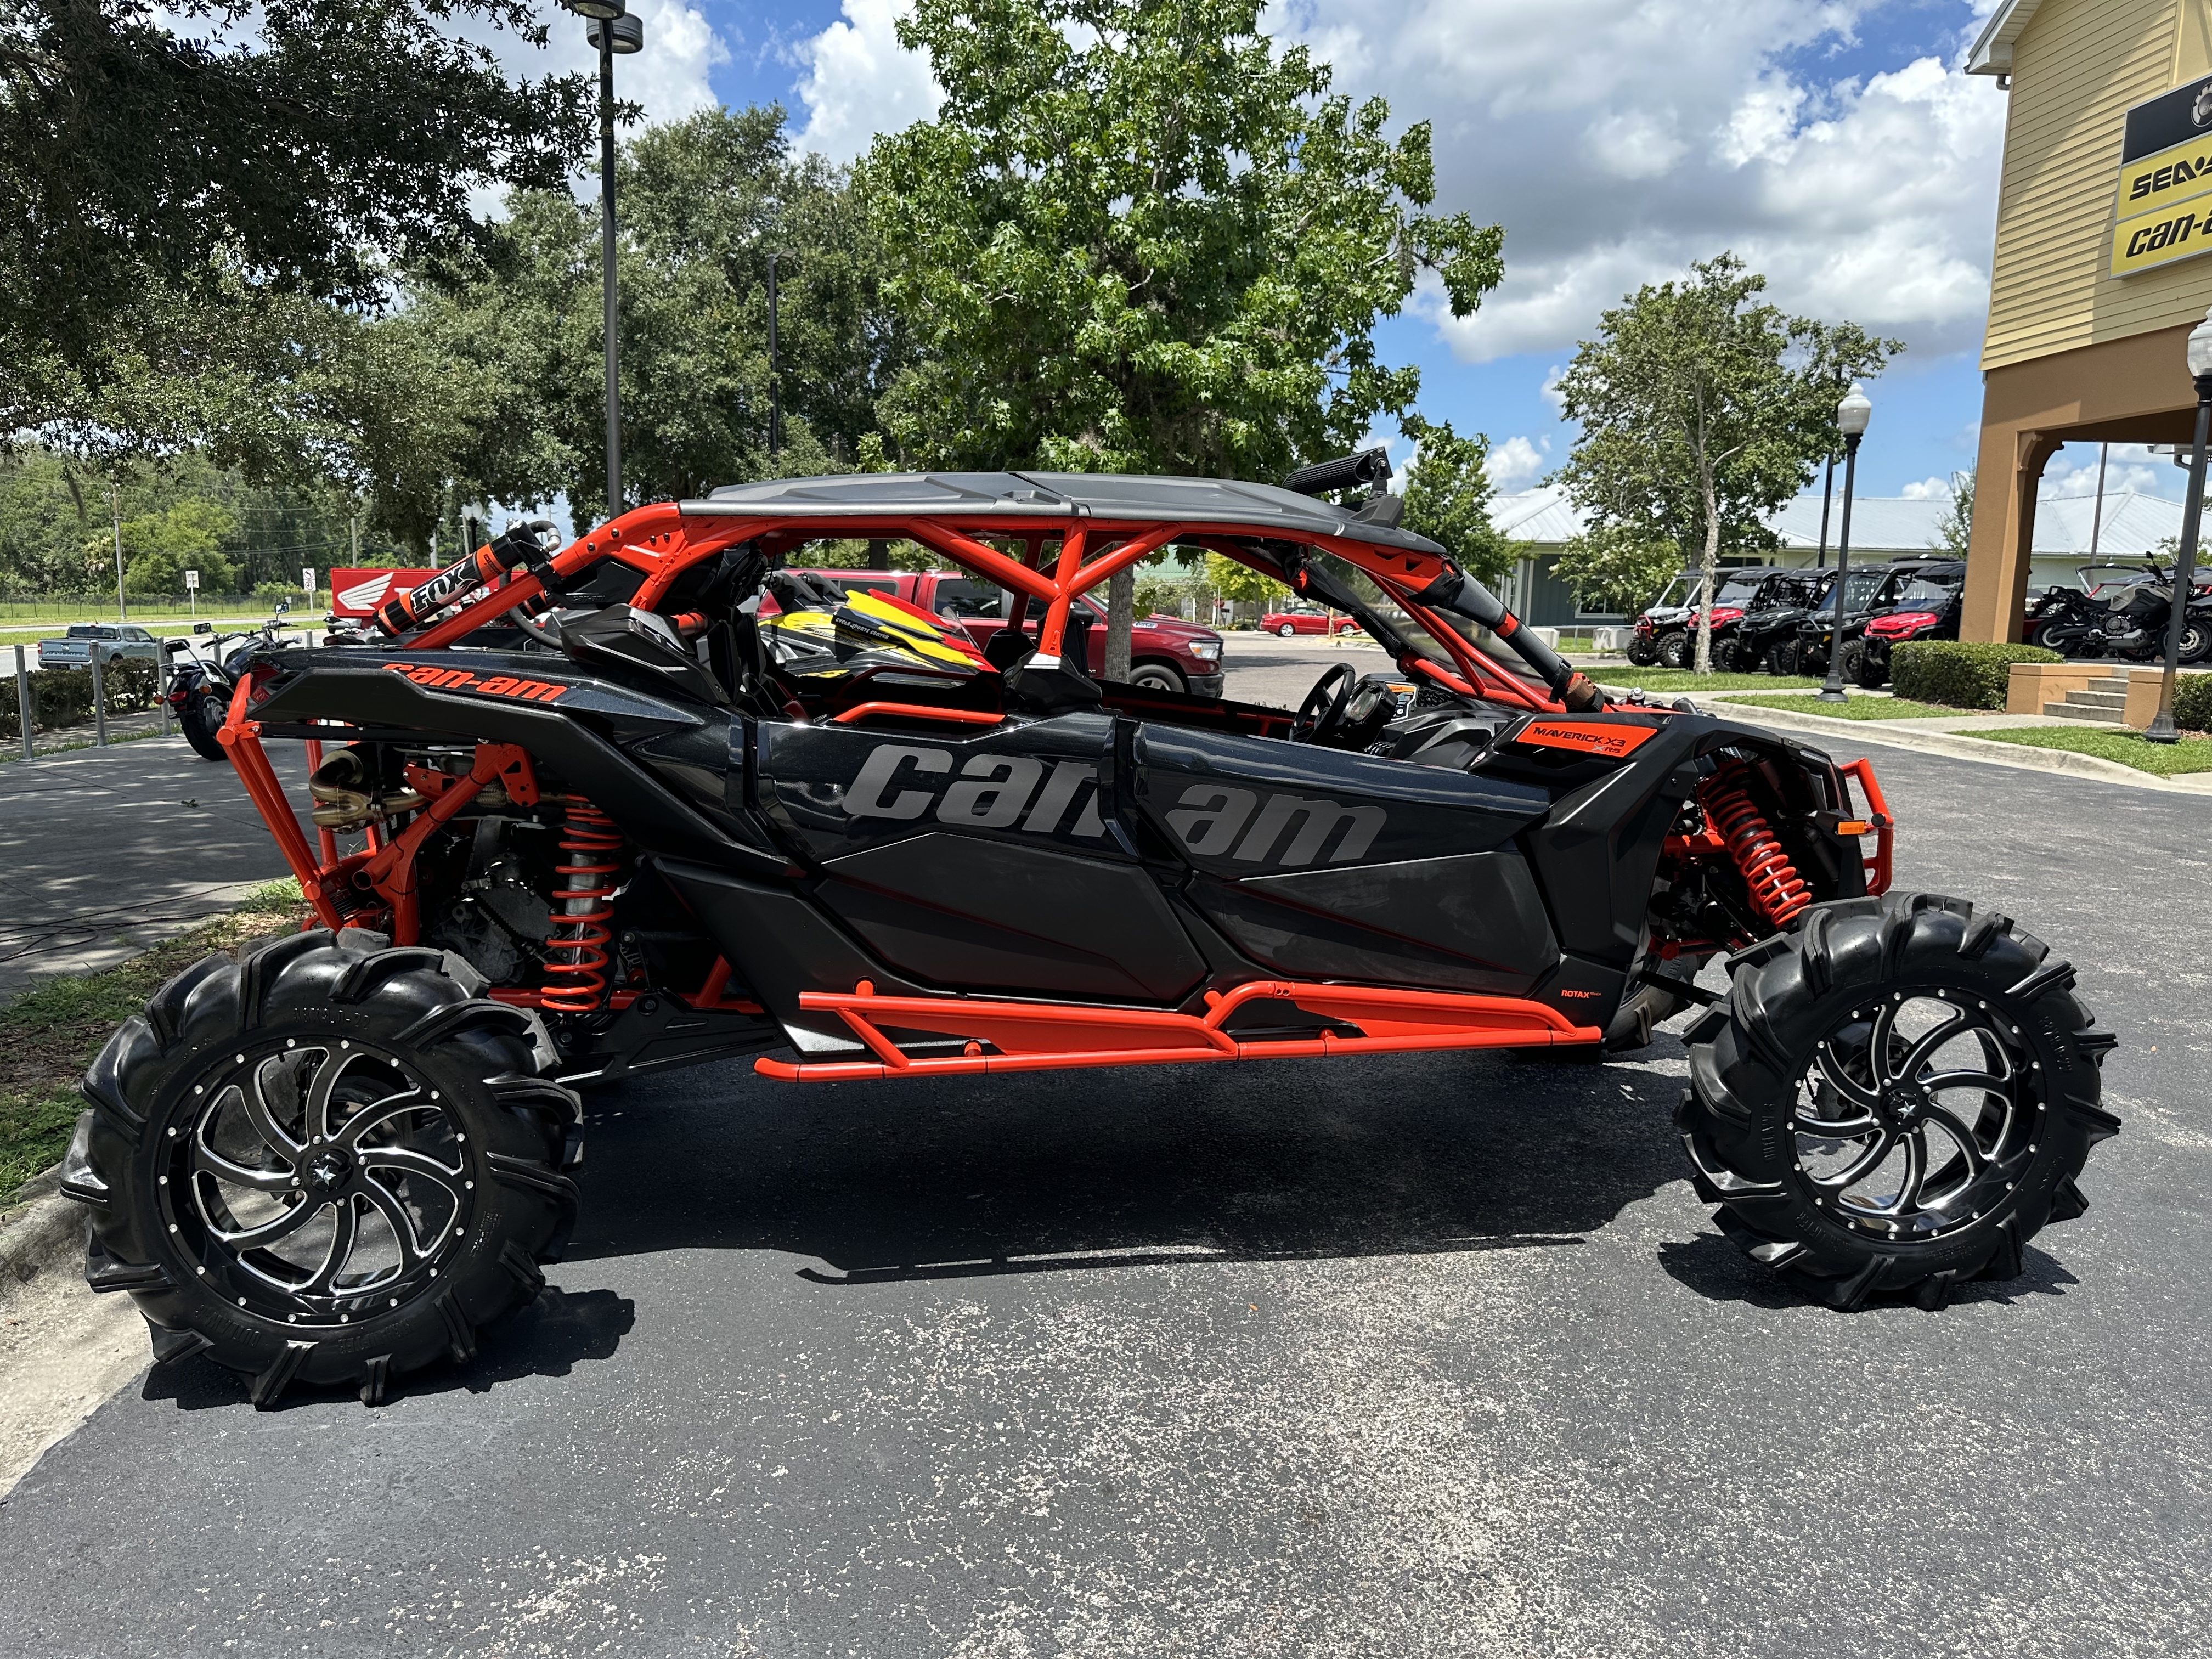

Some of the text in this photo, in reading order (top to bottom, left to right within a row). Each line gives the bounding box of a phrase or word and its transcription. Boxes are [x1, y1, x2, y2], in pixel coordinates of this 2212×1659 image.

[411, 561, 466, 614] FOX
[836, 617, 889, 640] CYCLE SPORTS CENTER
[1533, 726, 1626, 747] MAVERICK X3
[1561, 990, 1589, 998] ROTAX
